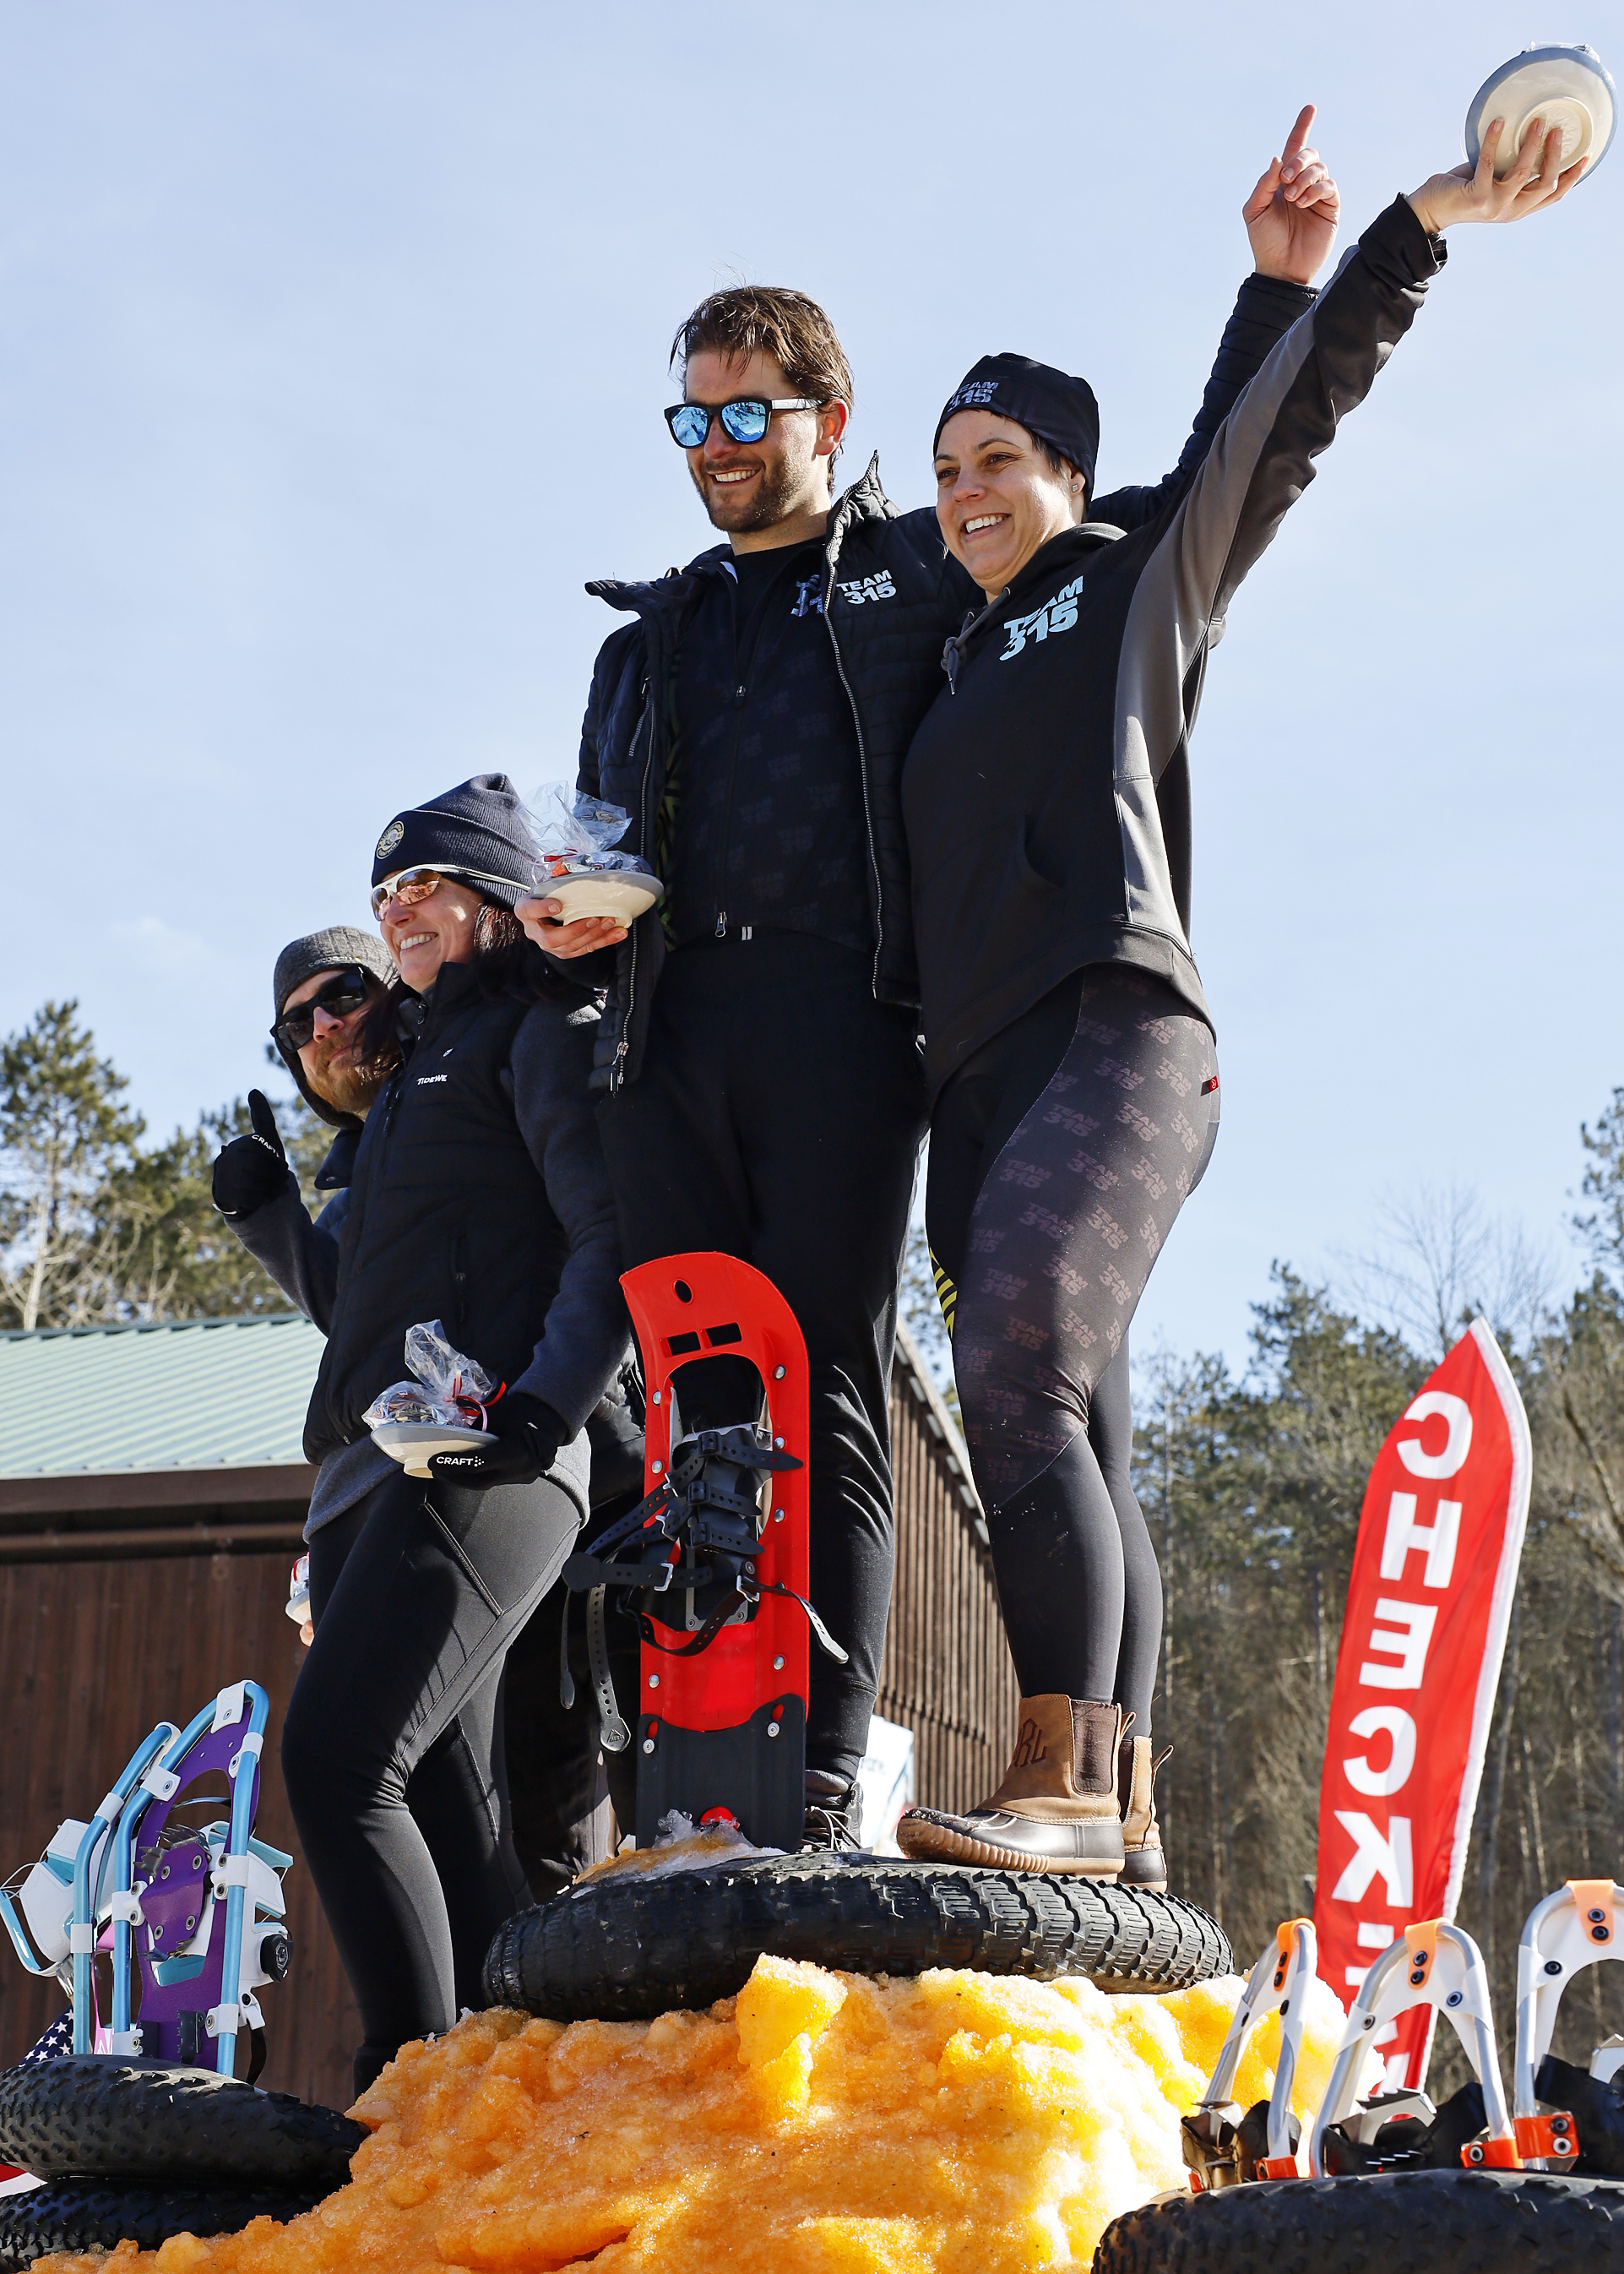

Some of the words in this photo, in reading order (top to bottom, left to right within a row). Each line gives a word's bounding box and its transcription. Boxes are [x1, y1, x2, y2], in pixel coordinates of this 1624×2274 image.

[947, 389, 993, 412] 315
[836, 569, 892, 592] TEAM
[844, 581, 897, 605] 315
[790, 590, 825, 617] 31
[1004, 575, 1084, 639] TEAM
[999, 596, 1078, 661] 315
[1077, 1024, 1113, 1045] 315
[1080, 1016, 1122, 1038] TEAM
[1133, 1017, 1170, 1044] 315
[1141, 1009, 1176, 1037] TEAM
[1094, 1064, 1135, 1091] 315
[1103, 1056, 1144, 1083] TEAM
[1155, 1064, 1186, 1098] 315
[1162, 1058, 1192, 1091] TEAM
[1042, 1111, 1092, 1137] 315
[1053, 1103, 1100, 1129] TEAM
[1115, 1109, 1155, 1142] 315
[1123, 1102, 1161, 1136] TEAM
[1177, 1110, 1199, 1148] TEAM
[1170, 1118, 1194, 1153] 315
[999, 1168, 1045, 1189] 315
[1007, 1159, 1053, 1179] TEAM
[1067, 1157, 1112, 1191] 315
[1077, 1149, 1120, 1183] TEAM
[1140, 1155, 1169, 1196] TEAM
[1132, 1164, 1162, 1200] 315
[1018, 1210, 1067, 1239] 315
[1028, 1202, 1074, 1232] TEAM
[1086, 1213, 1122, 1249] 315
[1096, 1205, 1129, 1243] TEAM
[970, 1238, 999, 1254] 315
[974, 1229, 1007, 1241] TEAM
[987, 1268, 1029, 1289] TEAM
[1042, 1262, 1082, 1296] 315
[1052, 1254, 1089, 1289] TEAM
[1107, 1261, 1132, 1299] TEAM
[980, 1277, 1022, 1301] 315
[1099, 1270, 1126, 1306] 315
[1003, 1327, 1044, 1351] 315
[1008, 1316, 1051, 1341] TEAM
[1060, 1318, 1091, 1349] 315
[1067, 1309, 1098, 1342] TEAM
[436, 1456, 474, 1466] CRAFT
